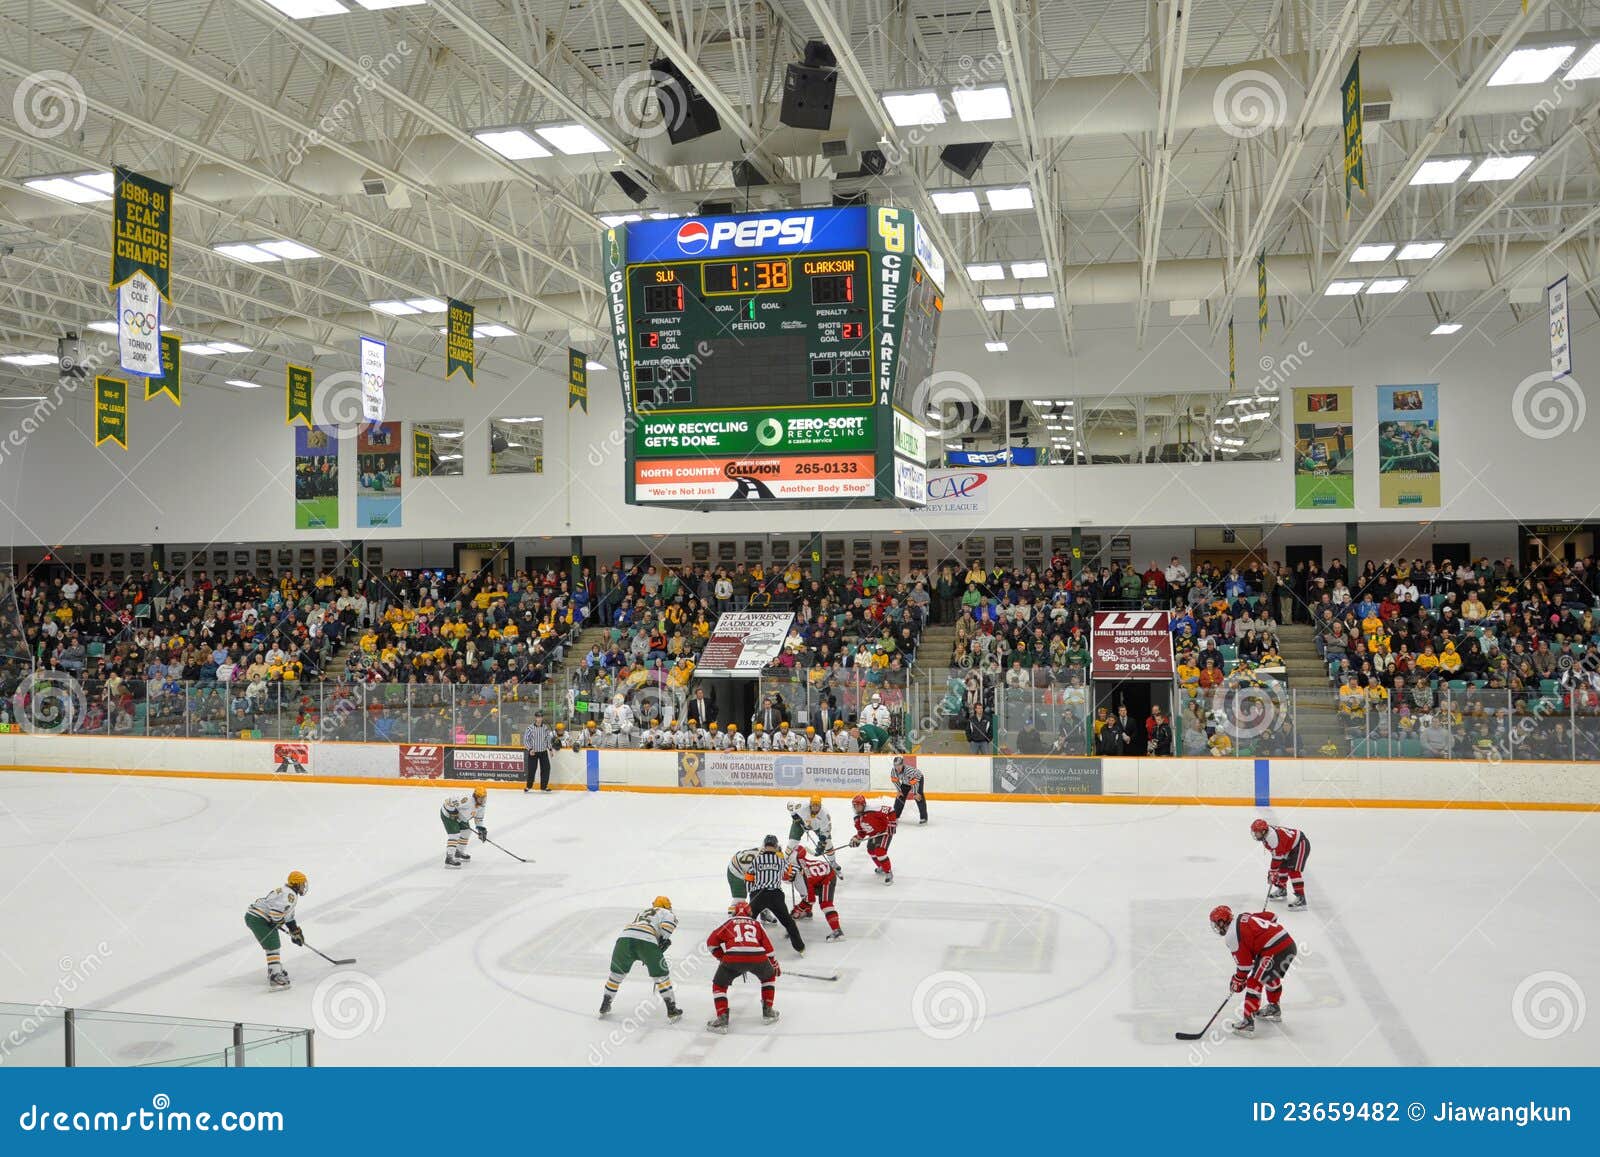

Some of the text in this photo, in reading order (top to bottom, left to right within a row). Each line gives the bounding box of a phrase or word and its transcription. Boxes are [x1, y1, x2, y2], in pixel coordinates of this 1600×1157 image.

[127, 202, 160, 228] ECAC
[117, 219, 168, 249] LEAGUE
[710, 216, 815, 249] PEPSI
[117, 240, 168, 269] CHAMPS
[804, 260, 855, 274] CLARKSON
[656, 270, 674, 282] SLU
[132, 279, 148, 293] ERIK
[882, 254, 902, 327] CHEEL
[131, 291, 149, 304] COLE
[609, 271, 626, 335] GOLDEN
[761, 302, 781, 310] GOAL
[732, 322, 766, 331] PERIOD
[843, 324, 862, 338] 21
[128, 338, 152, 351] TORINO
[650, 332, 658, 347] 2
[880, 332, 895, 405] ARENA
[618, 338, 632, 413] KNIGHTS
[645, 422, 748, 435] HOW RECYCLING
[788, 428, 864, 438] RECYCLING
[645, 435, 720, 447] GET'S DONE.
[641, 467, 721, 477] NORTH COUNTRY
[796, 462, 857, 474] 265-0133
[680, 487, 694, 496] Not
[697, 487, 715, 495] Just
[780, 484, 814, 493] Another
[818, 484, 840, 494] Body
[927, 476, 976, 498] CAC
[945, 503, 979, 512] LEAGUE
[1099, 613, 1162, 629] LTI
[1115, 646, 1160, 657] Body Shop
[456, 761, 521, 770] HOSPITAL
[711, 762, 773, 771] JOIN GRADUATES
[741, 772, 773, 780] DEMAND
[733, 924, 759, 943] 12
